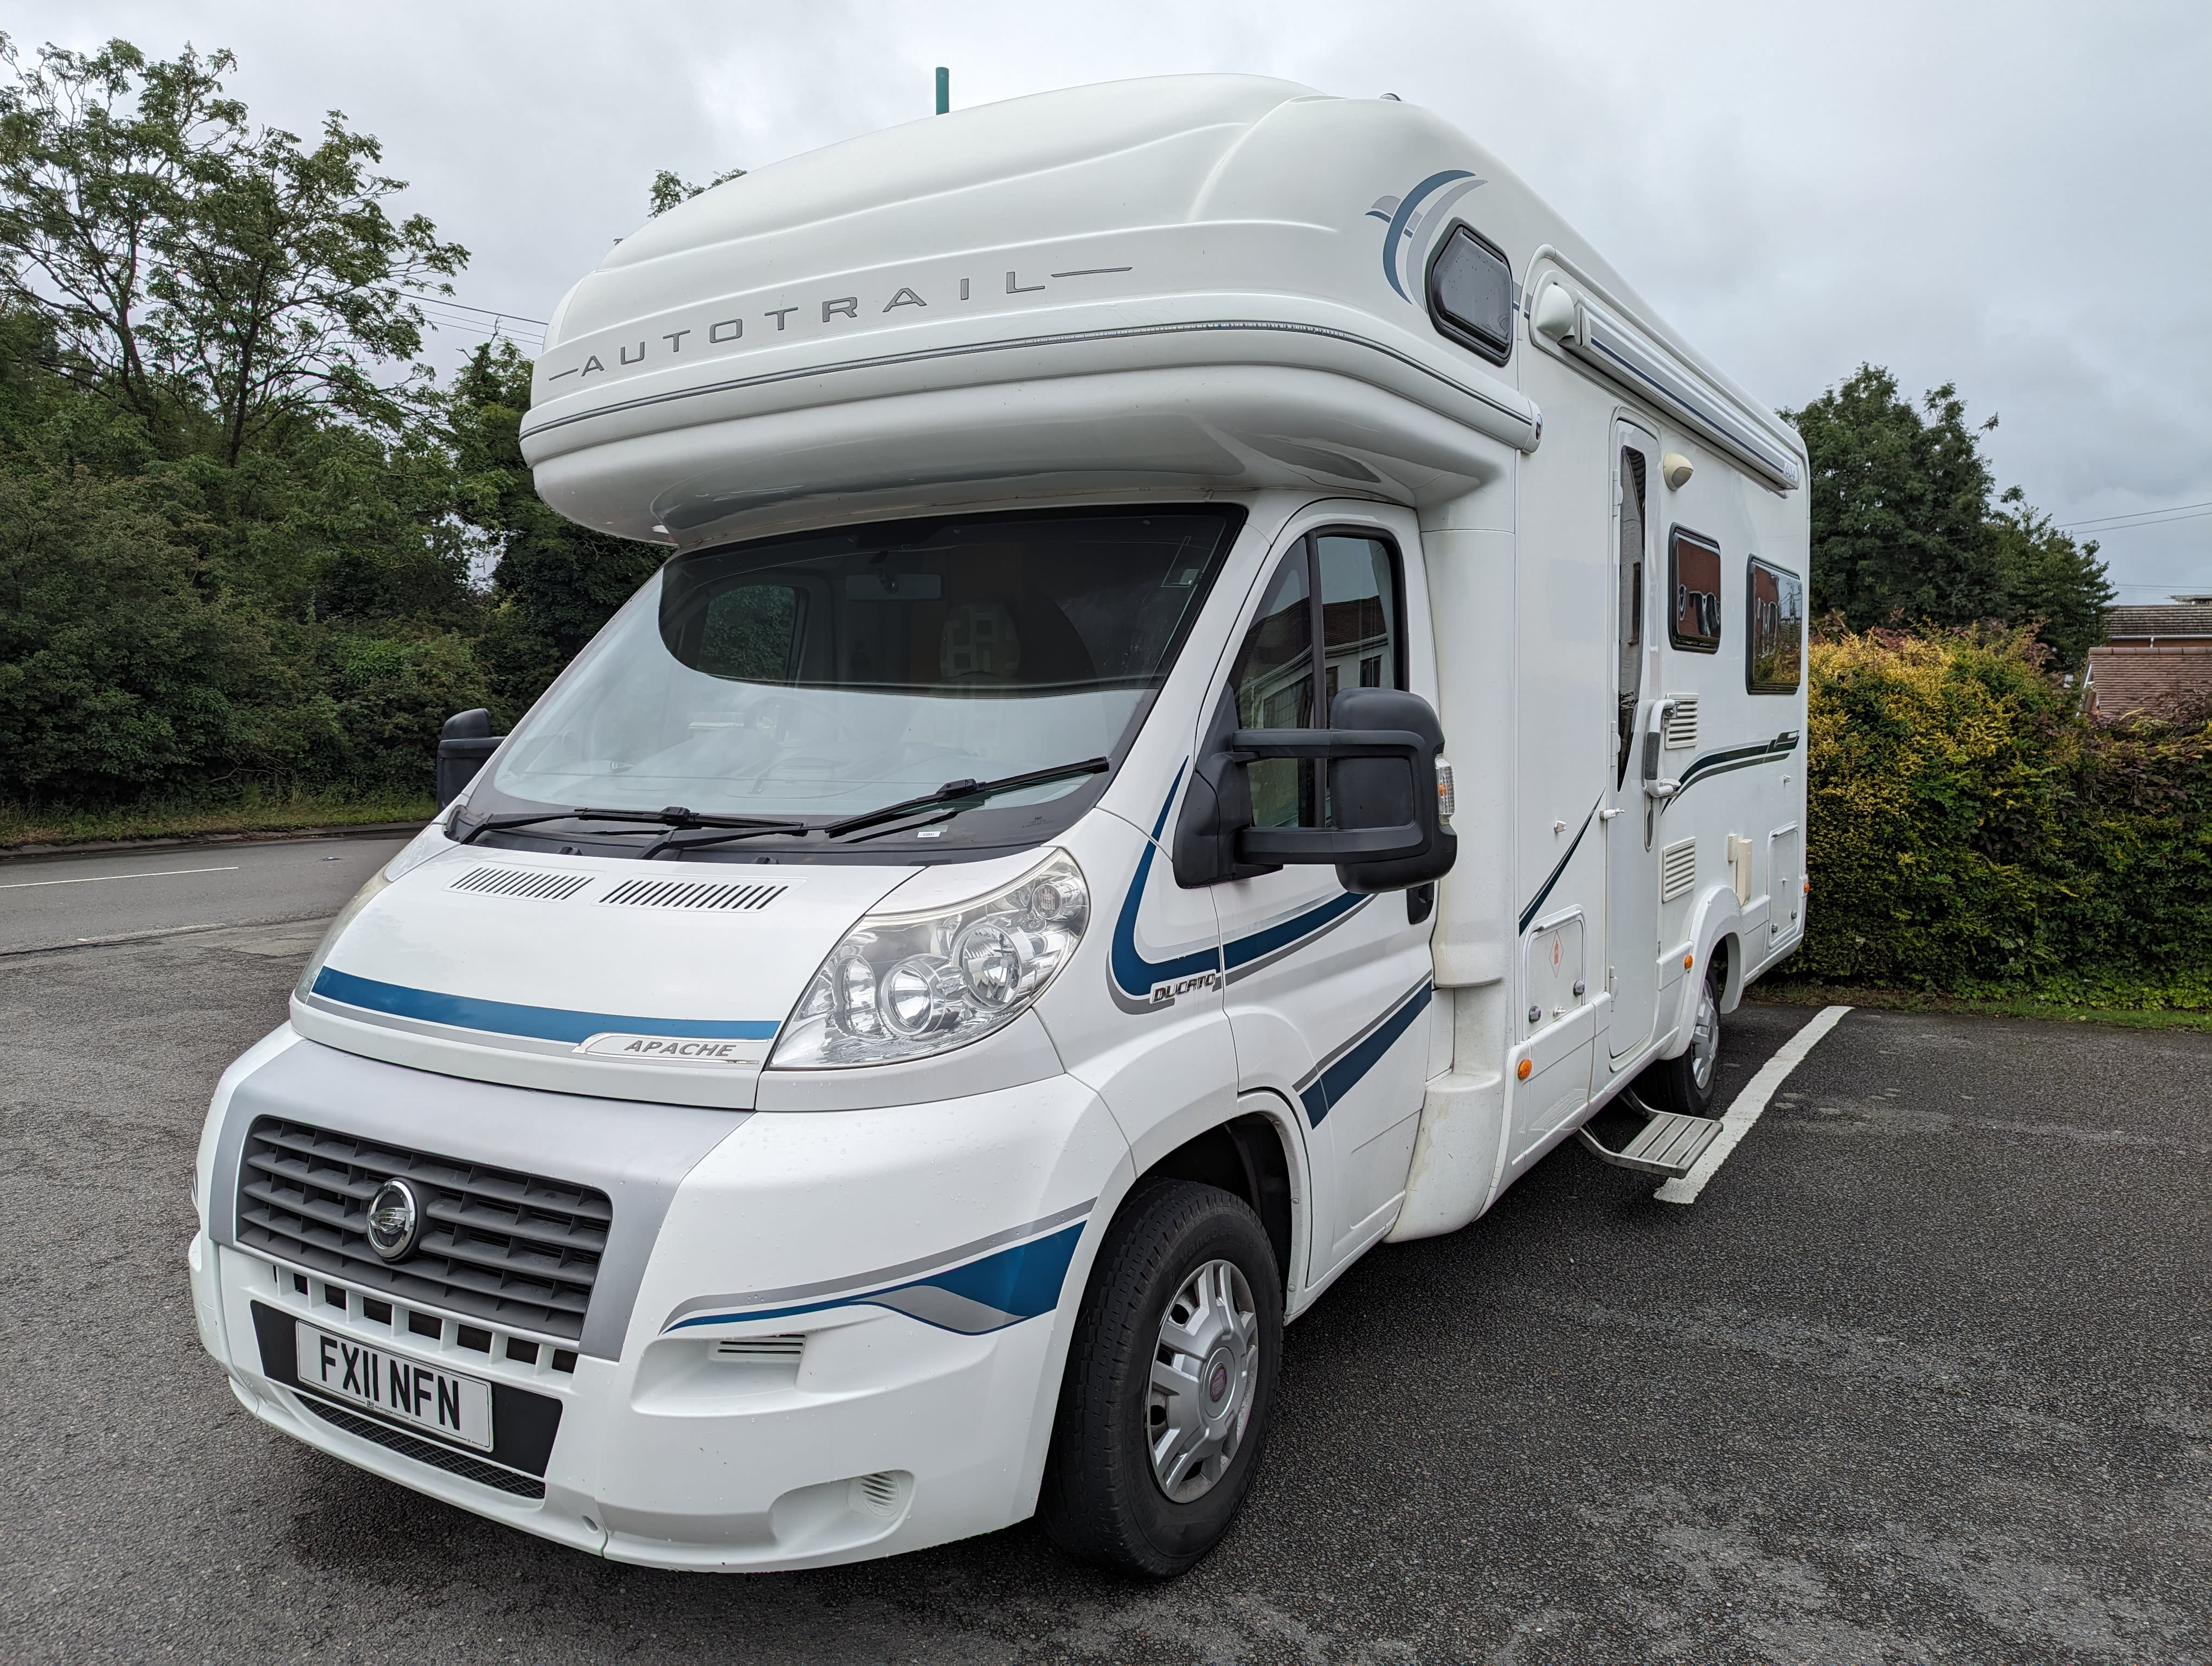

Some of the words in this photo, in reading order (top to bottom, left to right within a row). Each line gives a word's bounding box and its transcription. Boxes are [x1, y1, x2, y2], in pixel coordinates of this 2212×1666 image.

[581, 271, 1045, 377] AUTOTRAIL
[1785, 464, 1796, 480] 634
[1153, 973, 1216, 1002] DUCATO
[623, 1040, 737, 1056] APACHE
[320, 1335, 380, 1402] FX11
[390, 1359, 460, 1431] NFN
